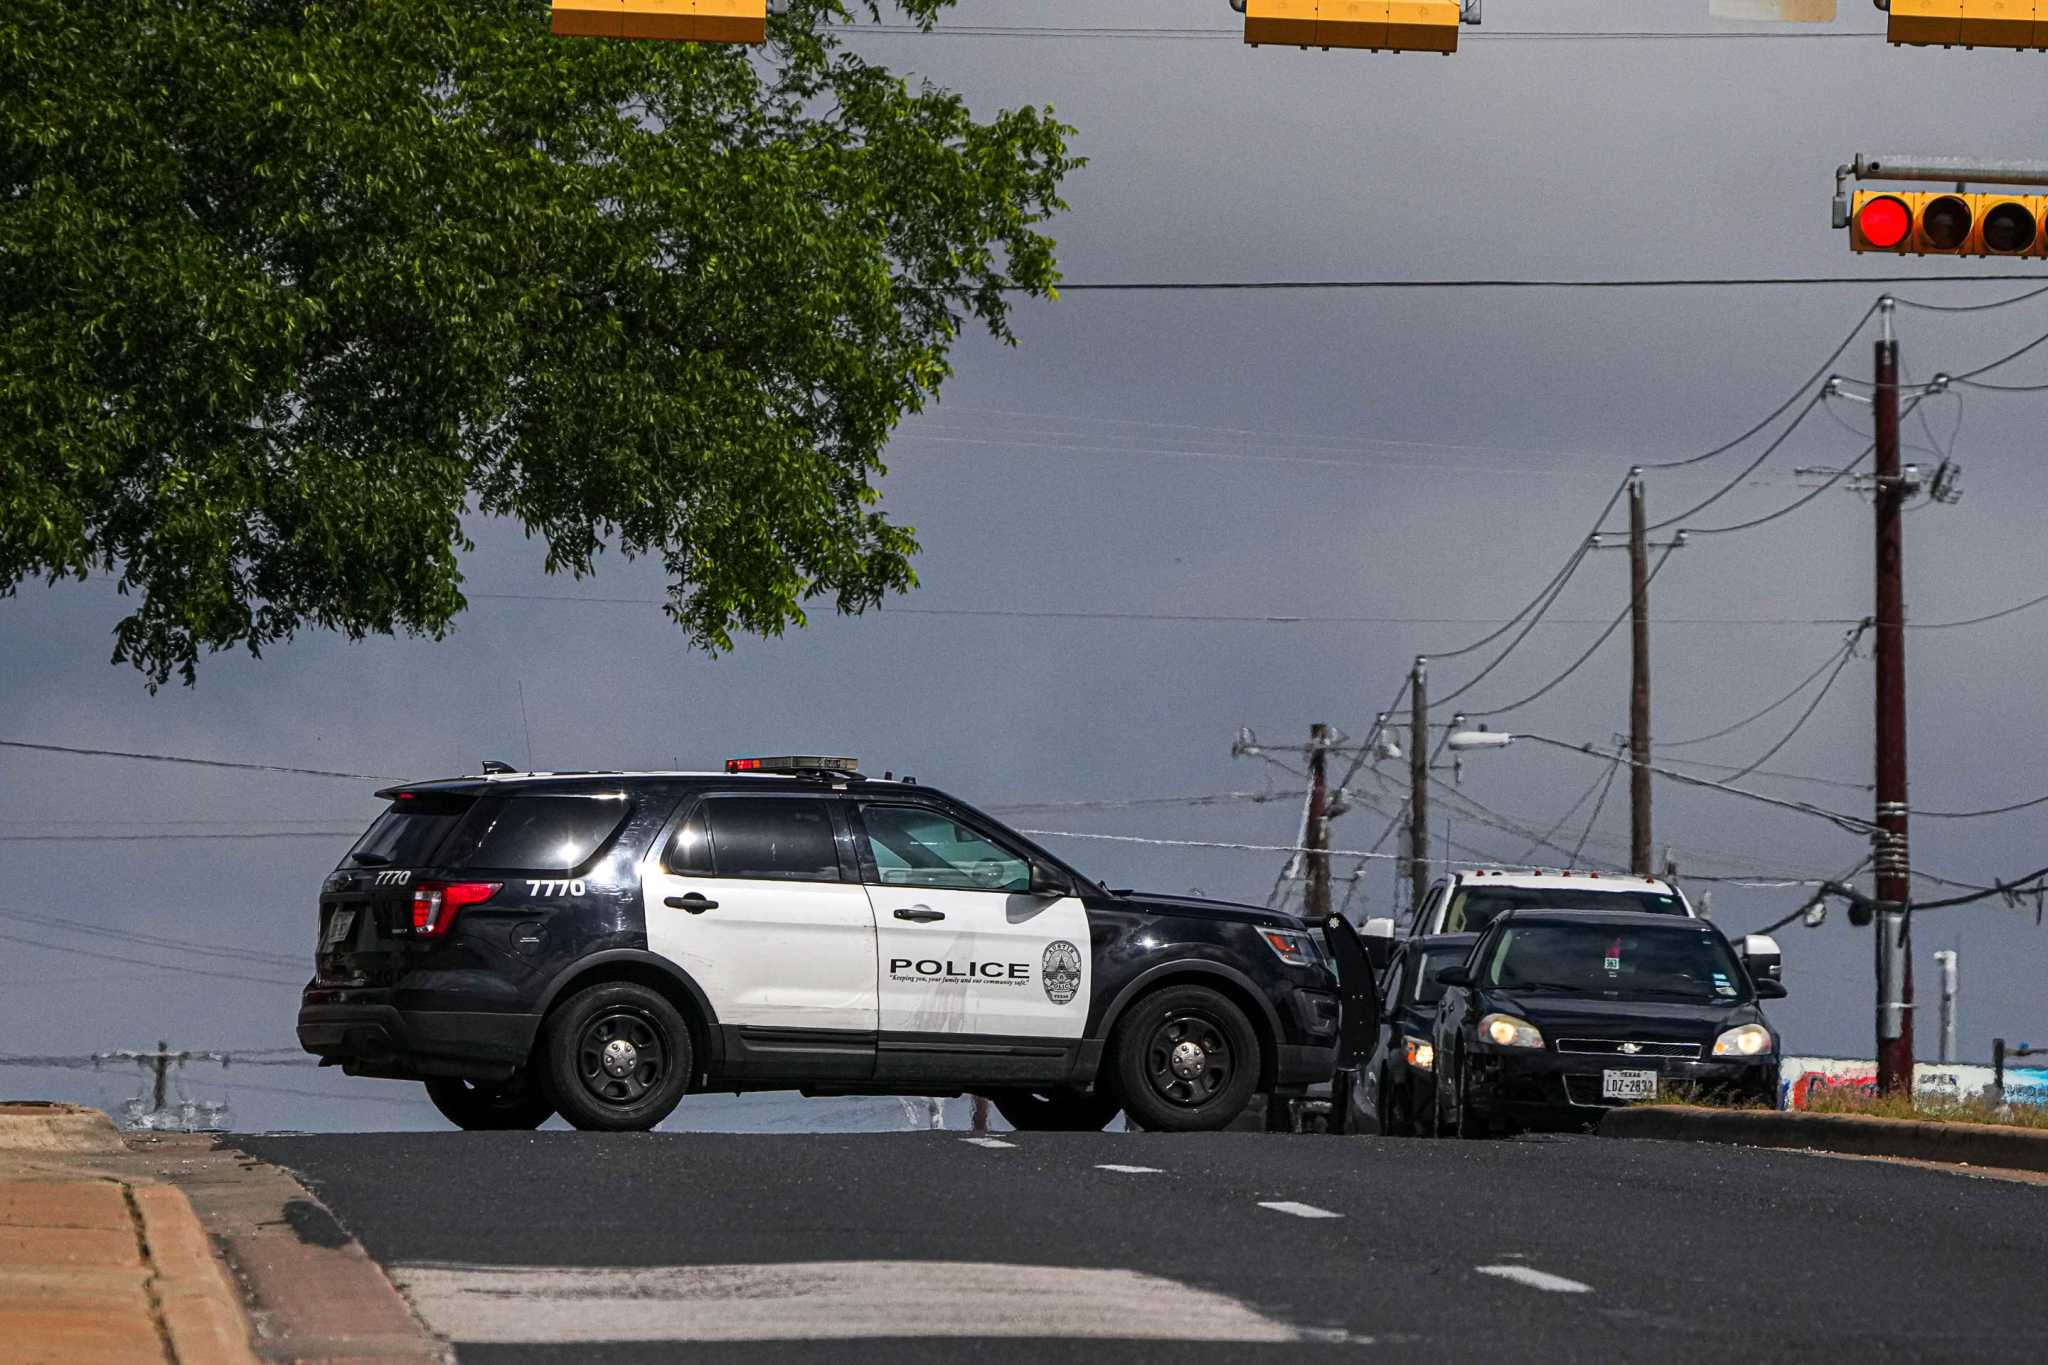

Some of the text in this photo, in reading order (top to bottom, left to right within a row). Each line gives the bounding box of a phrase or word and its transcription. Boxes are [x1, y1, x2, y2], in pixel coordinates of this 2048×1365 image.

[375, 871, 411, 886] 7770
[526, 879, 586, 897] 7770
[890, 958, 1030, 979] POLICE
